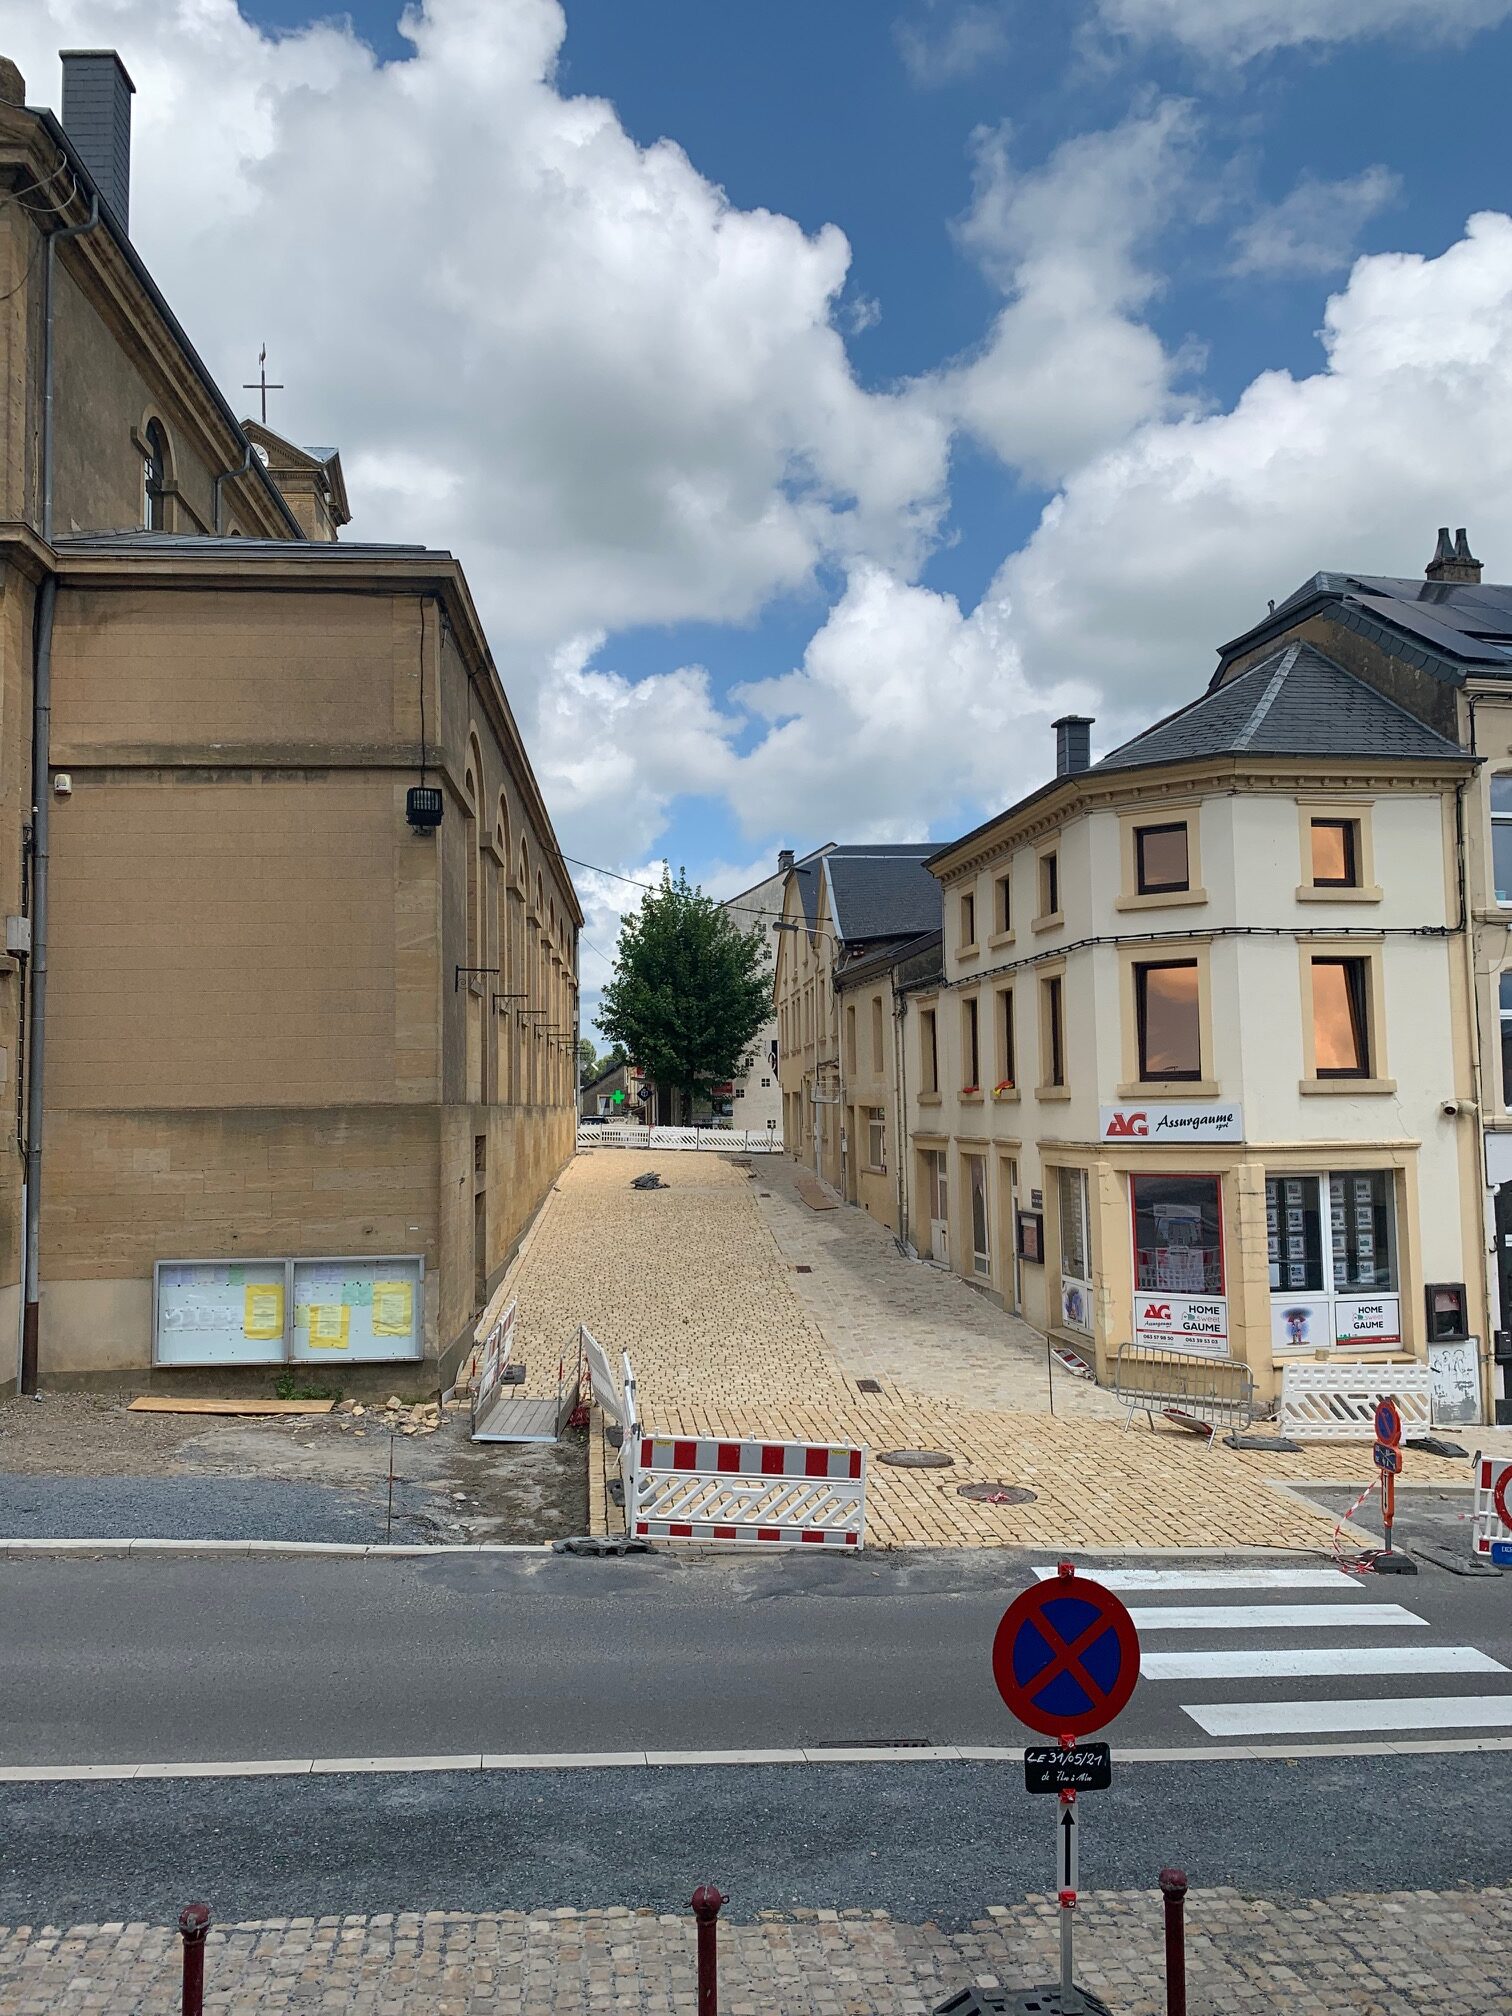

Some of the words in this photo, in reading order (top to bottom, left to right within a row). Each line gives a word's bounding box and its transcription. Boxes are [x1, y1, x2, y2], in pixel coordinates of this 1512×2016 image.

[1106, 1112, 1149, 1136] AG
[1155, 1113, 1234, 1132] Assurgaume
[1144, 1304, 1171, 1319] AG
[1189, 1305, 1220, 1315] HOME
[1358, 1306, 1383, 1314] HOME
[1197, 1315, 1220, 1323] sweet
[1183, 1322, 1221, 1332] GAUME
[1353, 1321, 1384, 1329] GAUME
[1027, 1753, 1047, 1763] LE
[1048, 1752, 1103, 1766] 31/05/21
[1041, 1770, 1050, 1781] de
